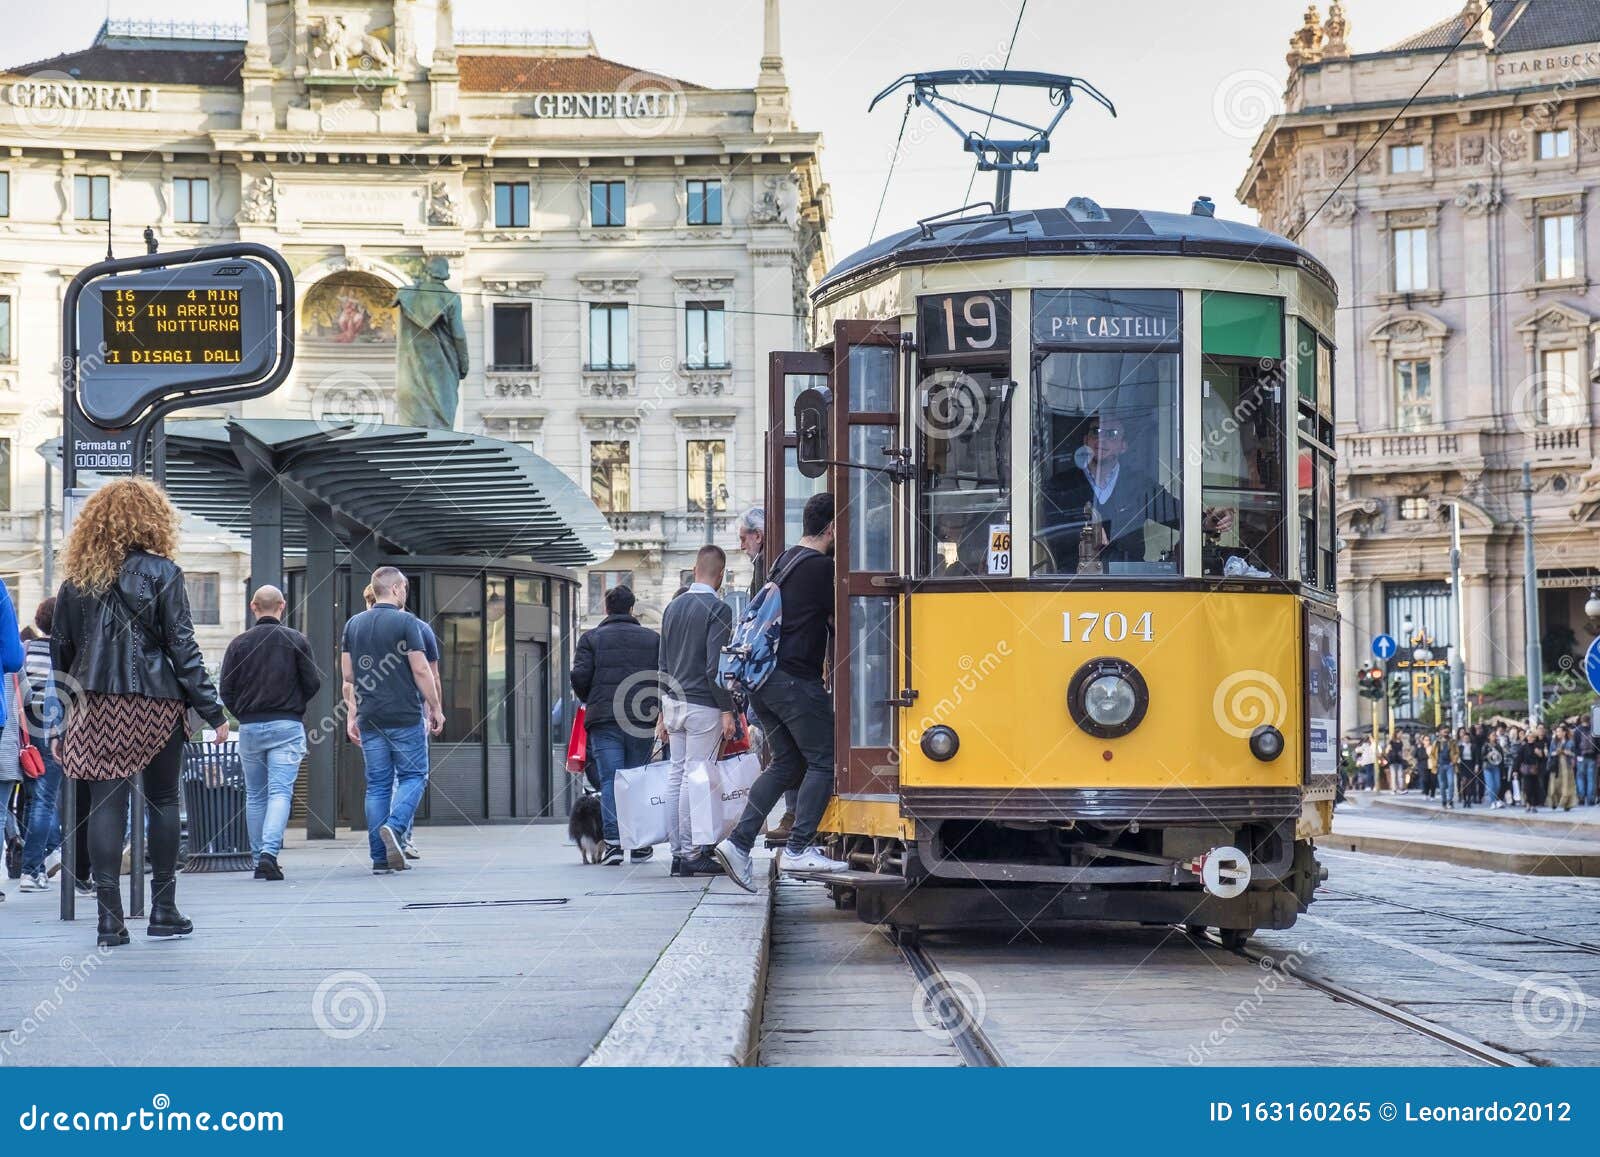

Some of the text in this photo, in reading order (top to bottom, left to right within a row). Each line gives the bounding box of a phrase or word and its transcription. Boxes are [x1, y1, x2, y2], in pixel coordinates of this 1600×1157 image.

[1496, 52, 1600, 75] STARBUCK
[8, 82, 159, 111] GENERALI
[534, 93, 676, 118] GENERALI
[116, 290, 238, 301] 16 4 MIN
[116, 305, 239, 316] 19 IN ARRIVO
[116, 320, 239, 332] M1 NOTTURNA
[943, 295, 997, 350] 19
[1087, 316, 1166, 337] CASTELLI
[131, 350, 191, 362] DISAGI
[75, 440, 117, 451] Fermata
[75, 454, 132, 467] 11494
[993, 534, 1010, 551] 46
[993, 554, 1009, 570] 19
[1061, 611, 1155, 642] 1704
